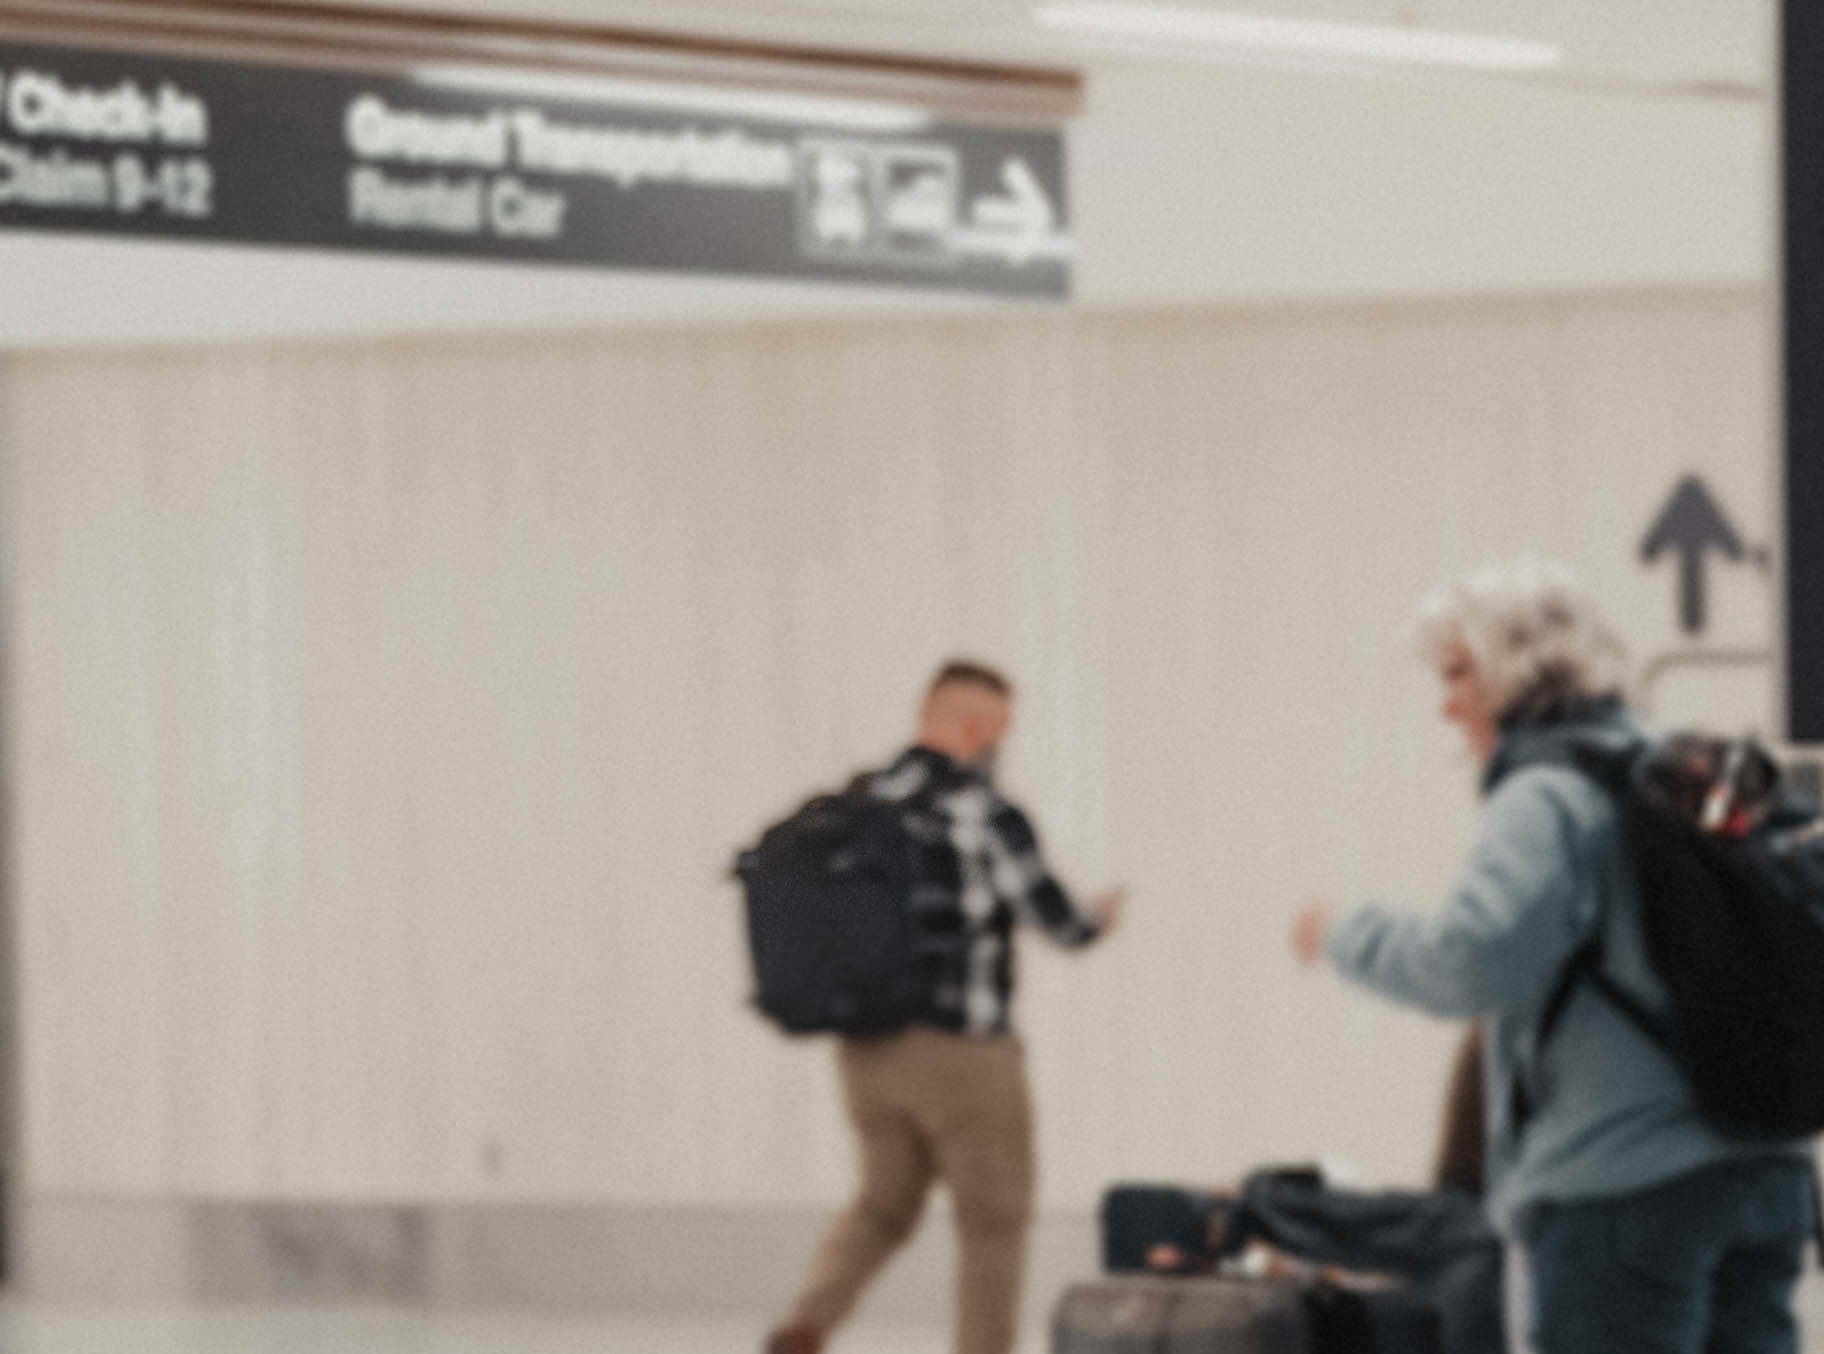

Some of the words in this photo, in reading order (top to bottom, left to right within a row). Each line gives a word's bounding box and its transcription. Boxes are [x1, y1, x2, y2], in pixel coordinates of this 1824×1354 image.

[345, 95, 505, 169] Ground
[512, 108, 793, 190] Transportation
[345, 165, 482, 232] Rental
[488, 174, 566, 239] Car
